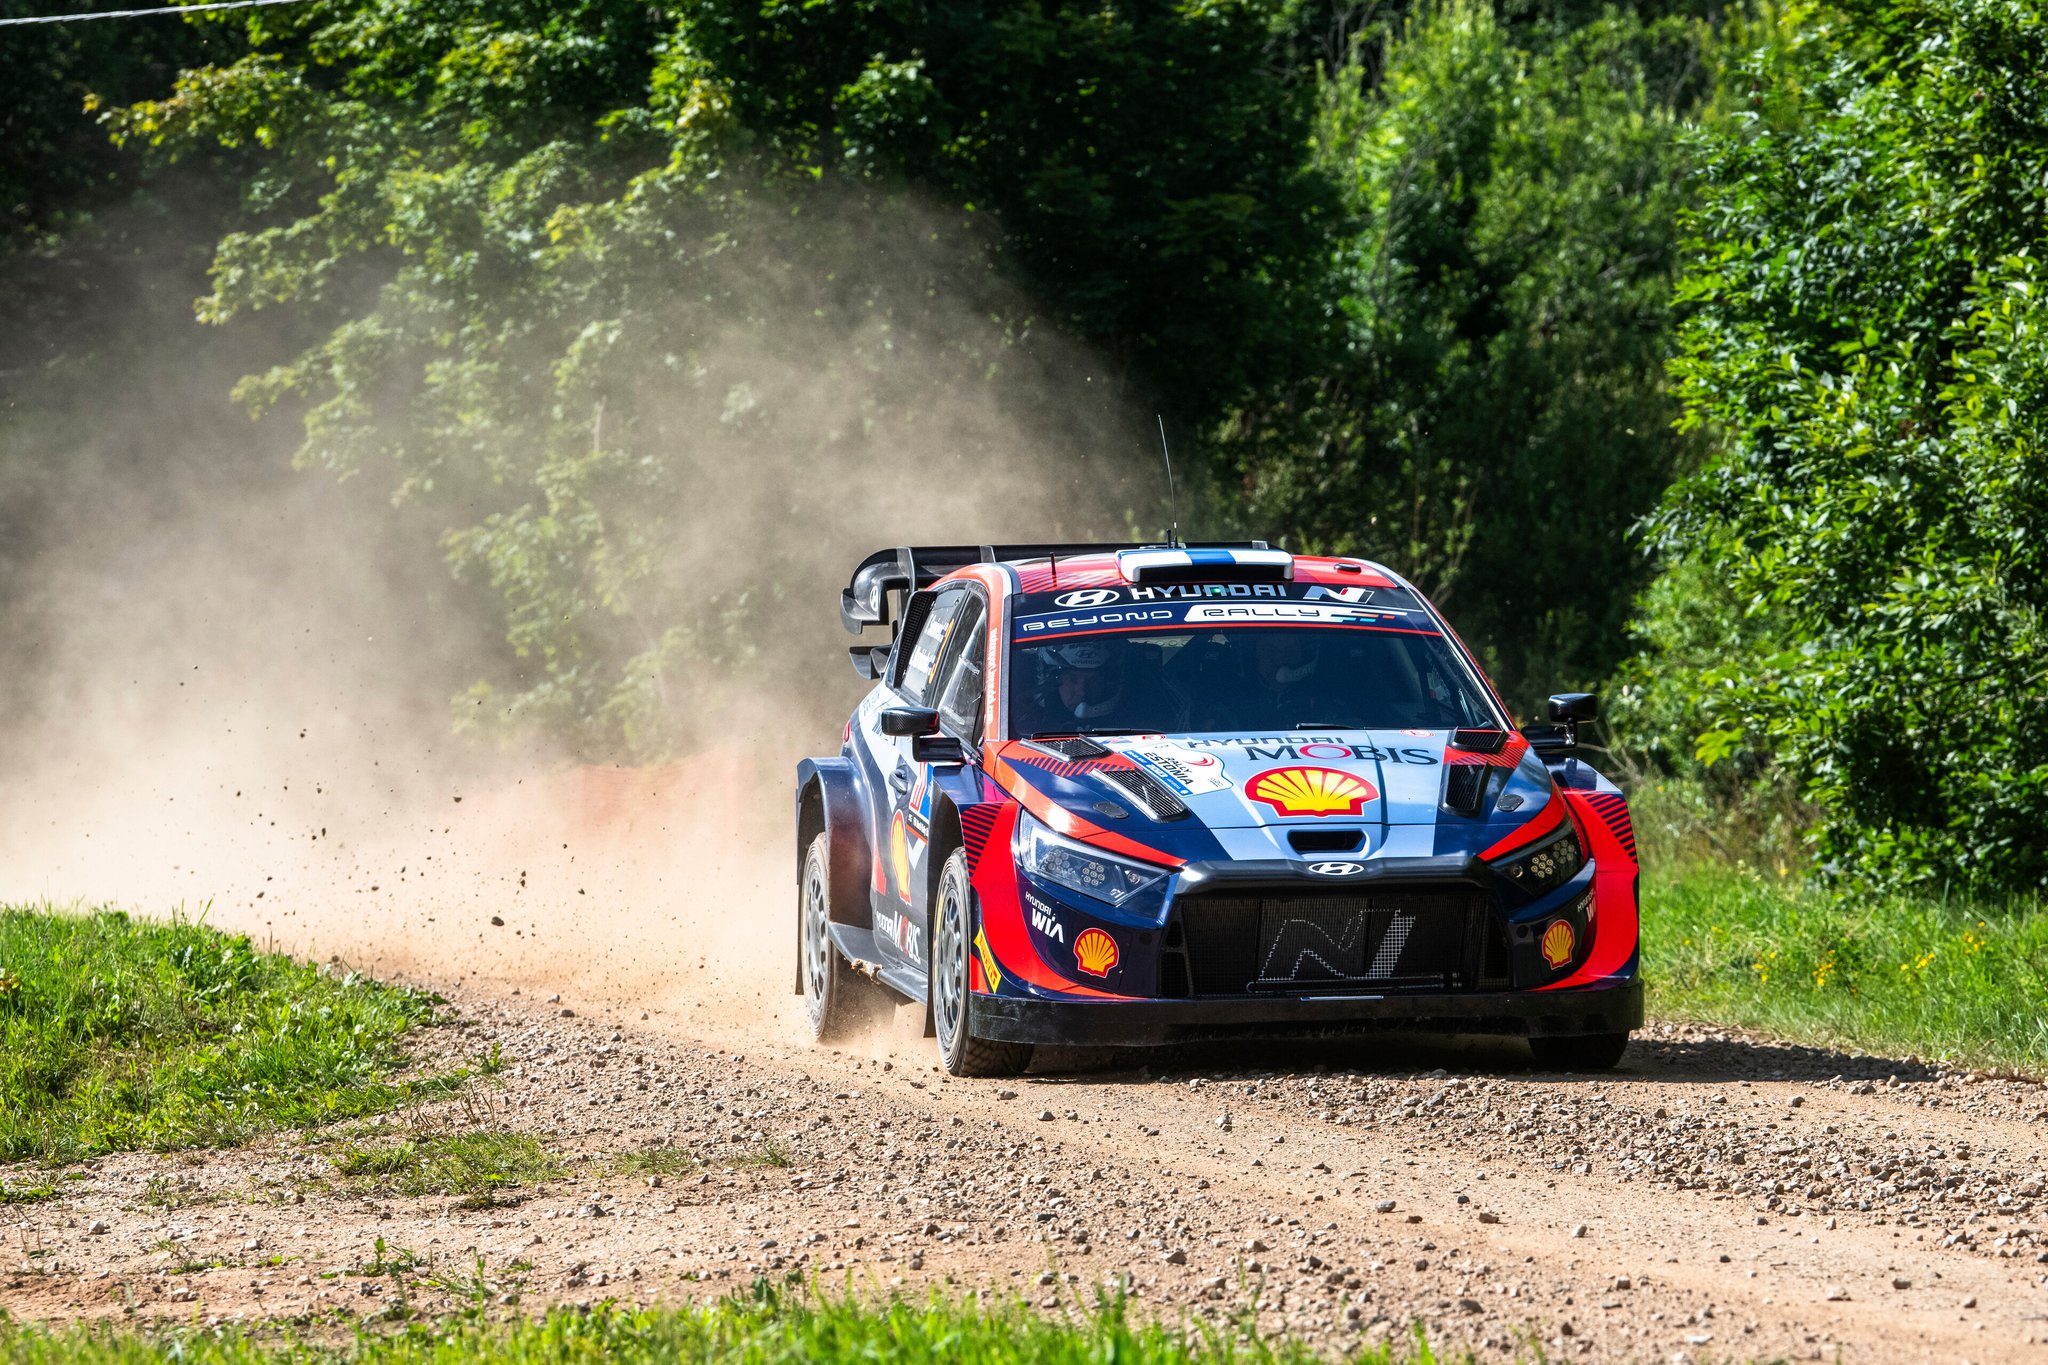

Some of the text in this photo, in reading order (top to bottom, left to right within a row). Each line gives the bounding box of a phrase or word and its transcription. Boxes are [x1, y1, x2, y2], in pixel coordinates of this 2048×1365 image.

[1131, 584, 1287, 600] HYUNDAI
[1022, 608, 1320, 631] BEYOND RALLY
[1187, 737, 1345, 748] HYUNDAI
[1249, 743, 1439, 765] MOBIS
[1143, 752, 1195, 785] ESTONIA
[1165, 757, 1193, 773] RALLY
[1025, 891, 1052, 916] HYUNDAI
[1031, 907, 1064, 943] WIA
[893, 910, 921, 965] MOBIS
[979, 933, 998, 985] PIRELLI
